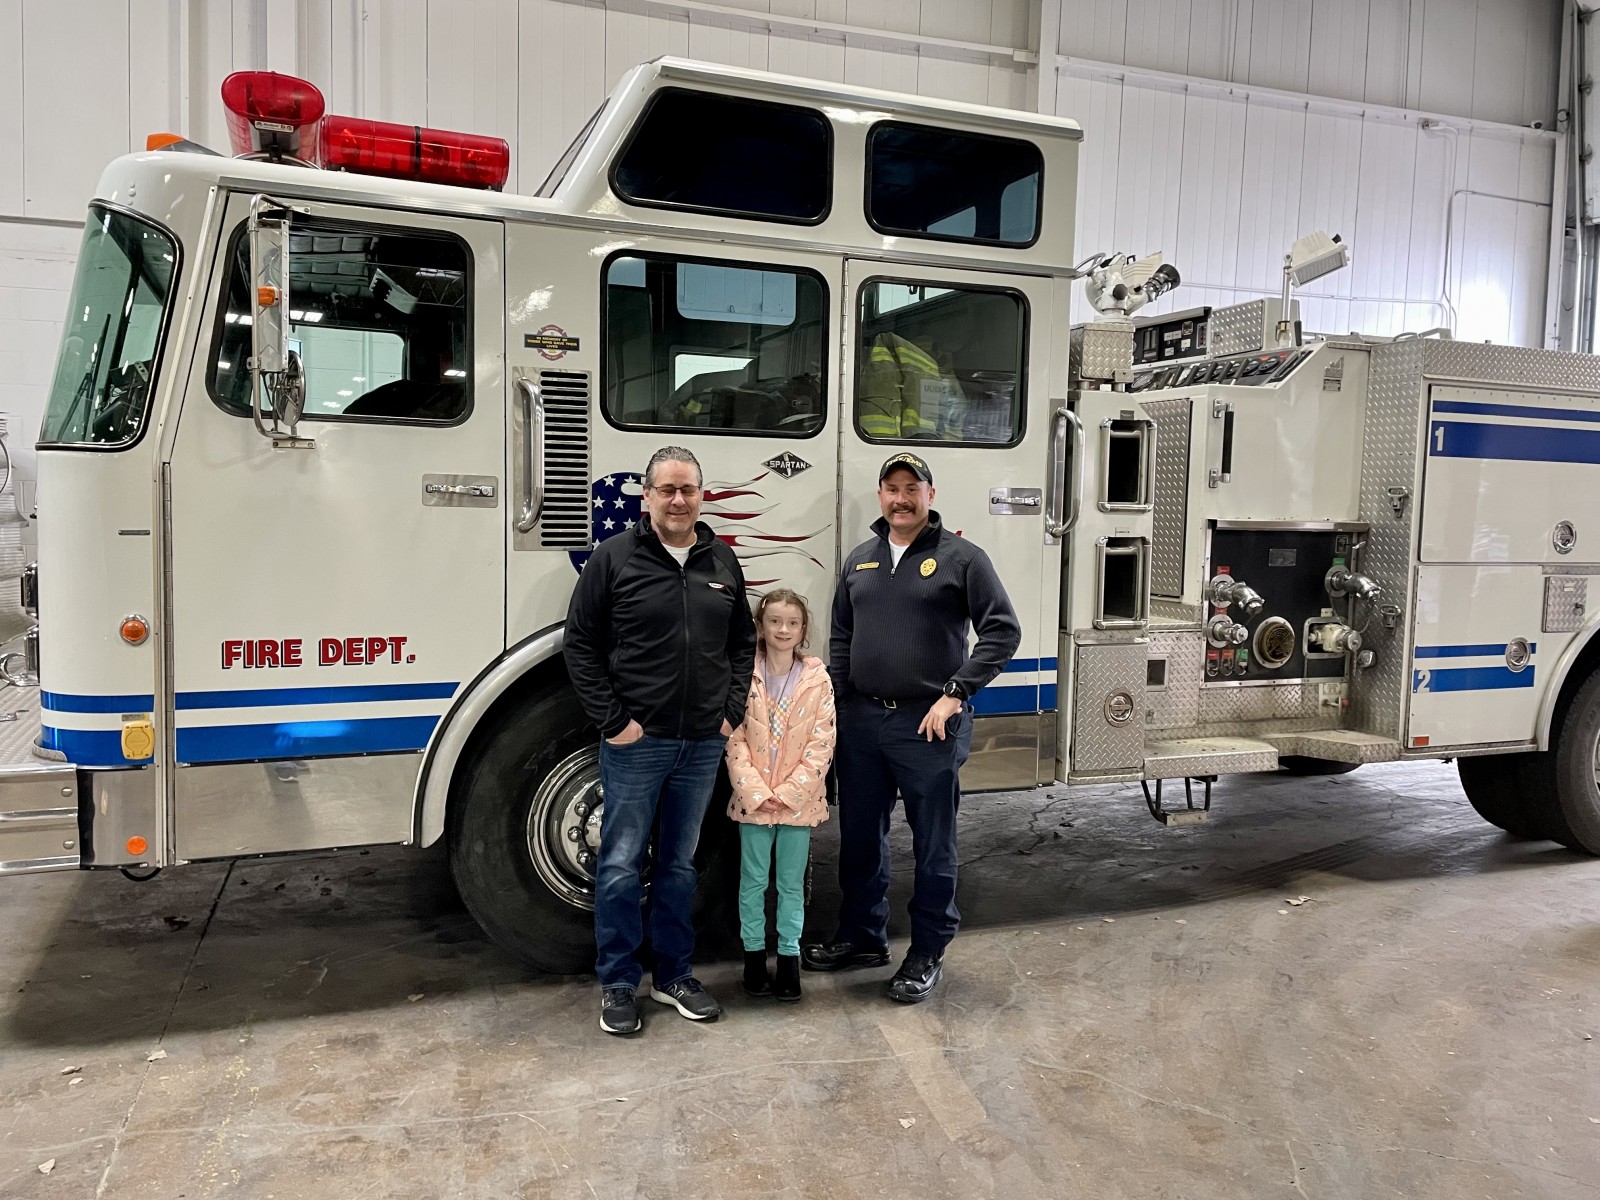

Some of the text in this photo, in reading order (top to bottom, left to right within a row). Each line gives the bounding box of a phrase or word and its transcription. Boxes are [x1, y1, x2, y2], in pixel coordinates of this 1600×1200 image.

[1435, 426, 1444, 451] 1
[769, 460, 806, 469] SPARTAN
[221, 636, 416, 669] FIRE DEPT.
[1417, 669, 1431, 693] 2
